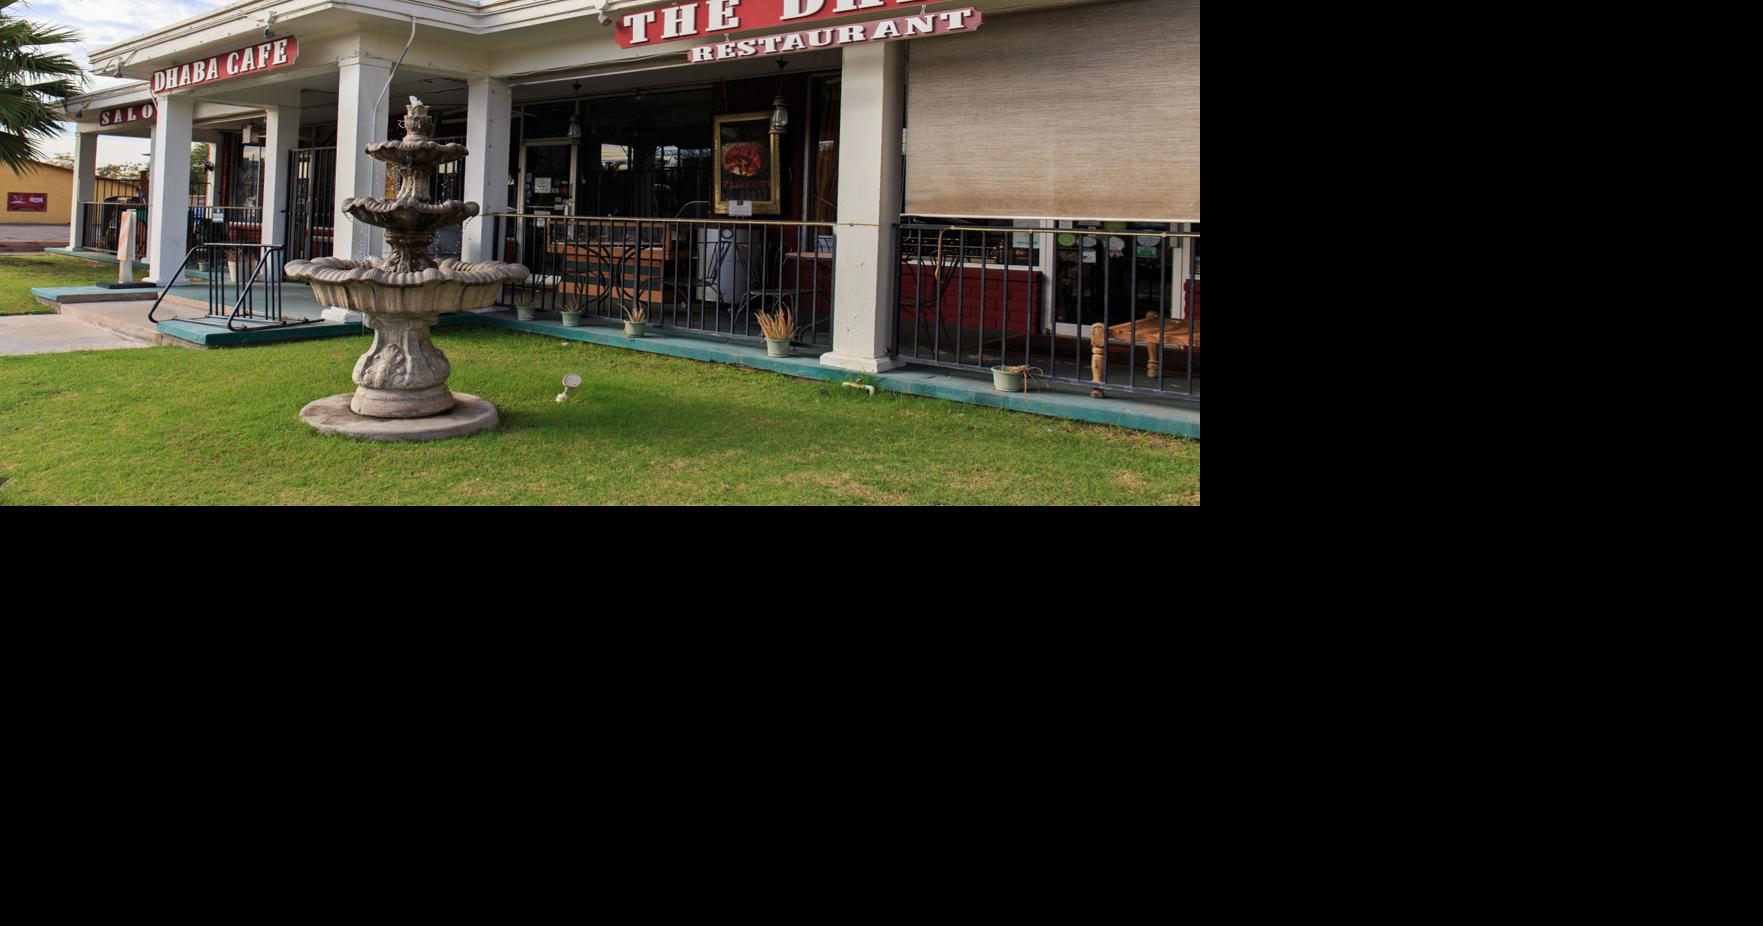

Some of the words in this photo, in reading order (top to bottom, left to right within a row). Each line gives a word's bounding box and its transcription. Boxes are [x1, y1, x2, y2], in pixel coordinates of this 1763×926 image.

[623, 0, 740, 44] THE
[691, 9, 972, 62] RESTAURANT
[153, 57, 219, 92] DHABA
[226, 38, 288, 75] CAFE
